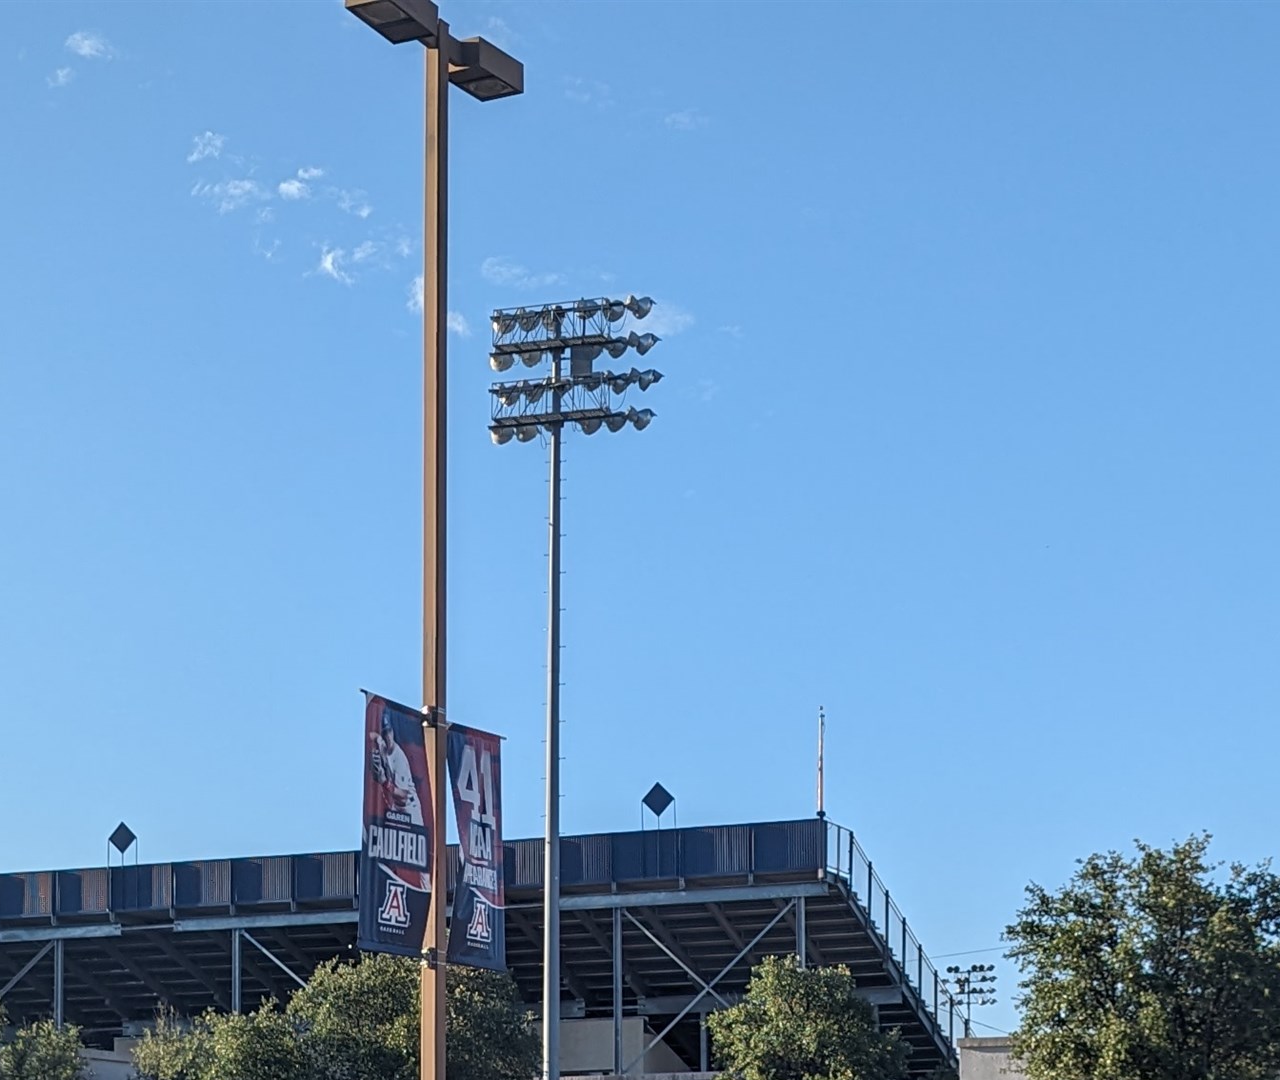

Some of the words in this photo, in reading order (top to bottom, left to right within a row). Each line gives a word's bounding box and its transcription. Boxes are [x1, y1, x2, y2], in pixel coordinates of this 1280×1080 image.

[457, 744, 496, 830] 41
[385, 811, 411, 823] GAREN
[368, 824, 427, 868] CAULFIELD
[378, 880, 411, 928] A
[466, 897, 492, 943] A
